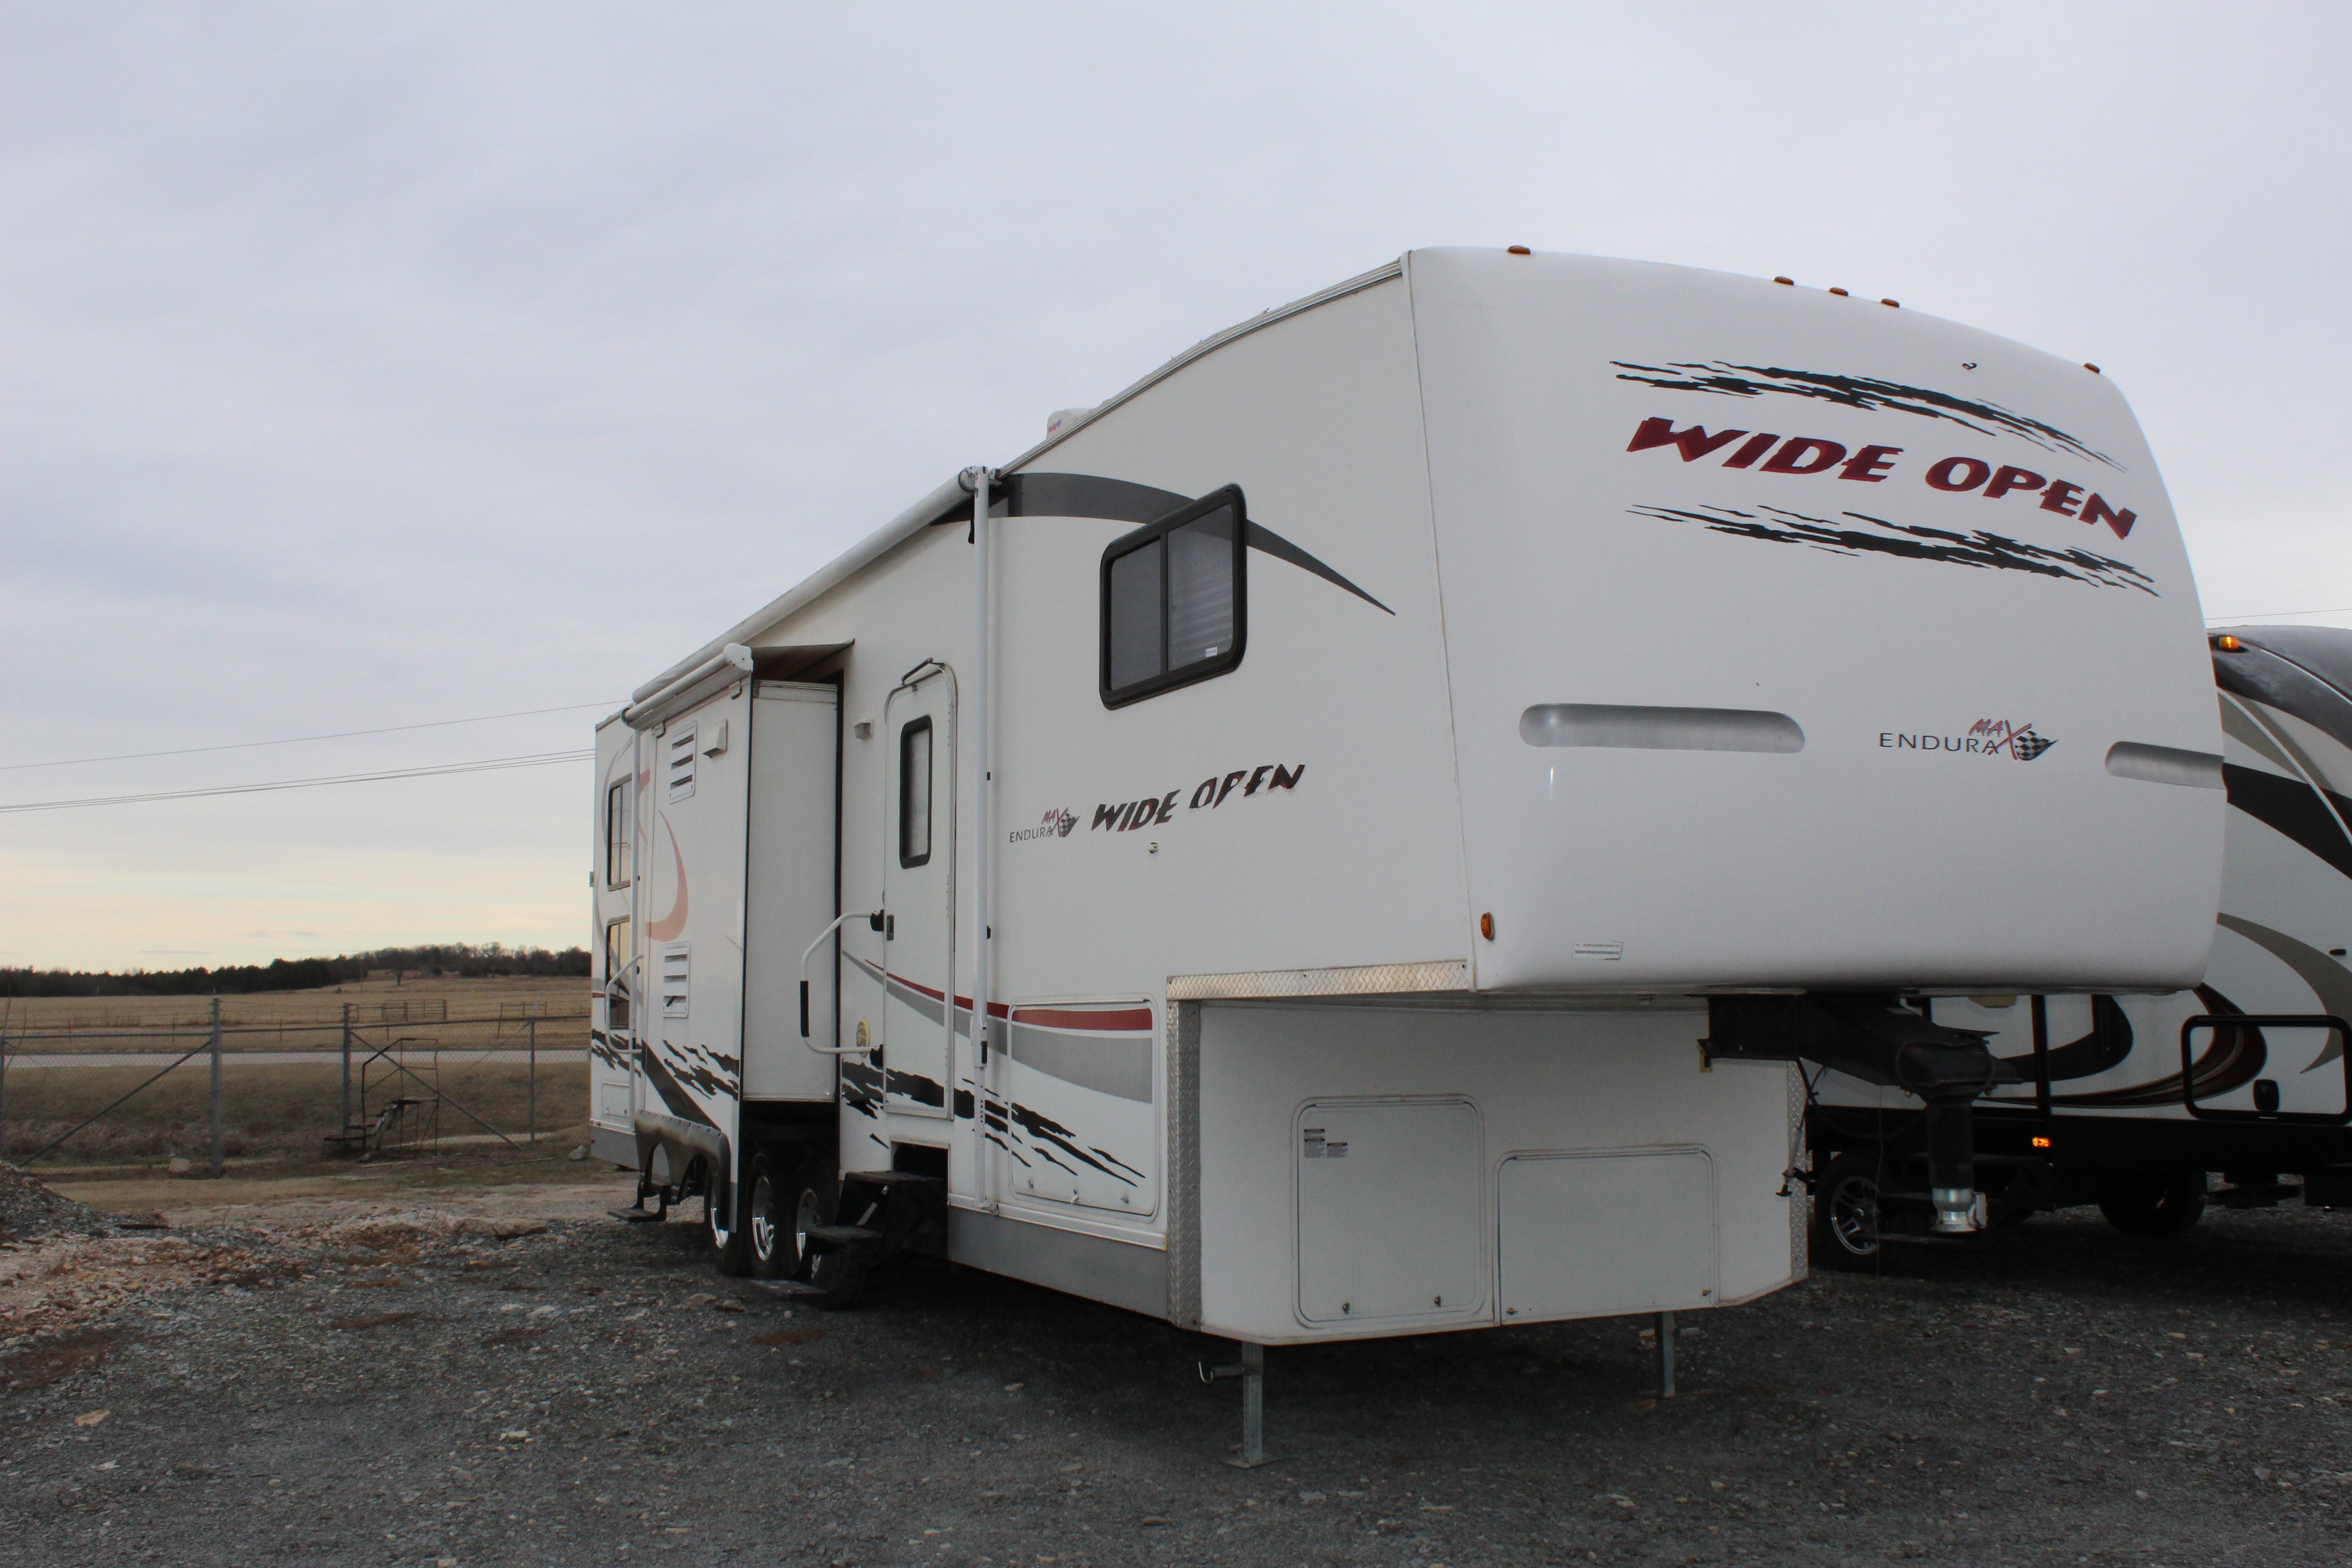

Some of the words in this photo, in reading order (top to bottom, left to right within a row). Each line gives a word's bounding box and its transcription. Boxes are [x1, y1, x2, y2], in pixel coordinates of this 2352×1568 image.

[1626, 416, 1904, 482] WIDE
[1925, 456, 2138, 540] OPEN
[1091, 789, 1181, 832] WIDE
[1189, 764, 1306, 809] OPEN
